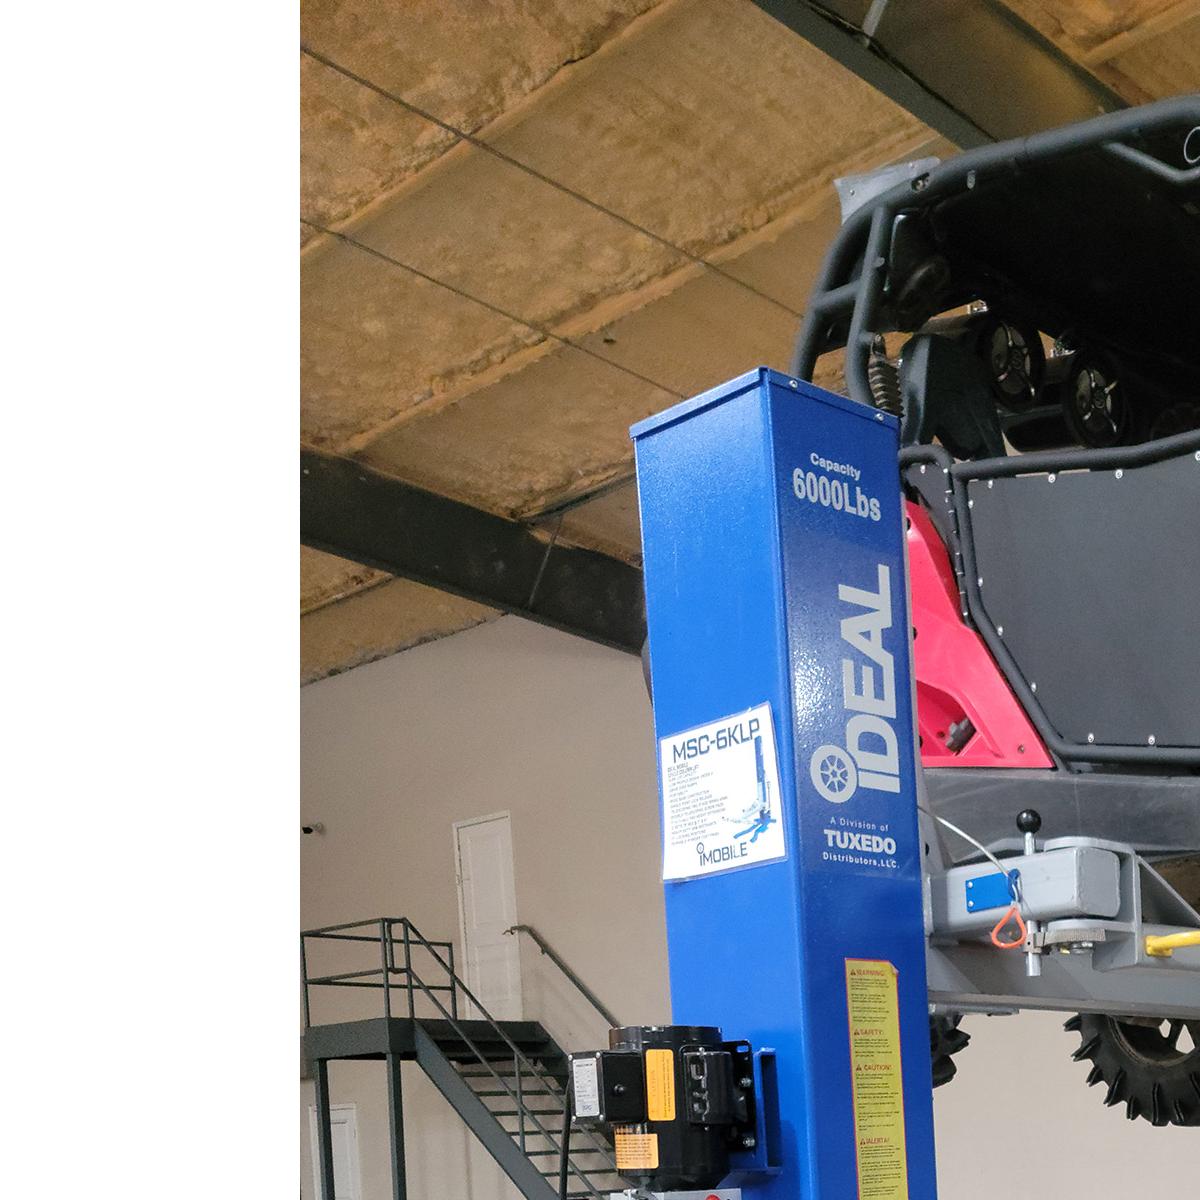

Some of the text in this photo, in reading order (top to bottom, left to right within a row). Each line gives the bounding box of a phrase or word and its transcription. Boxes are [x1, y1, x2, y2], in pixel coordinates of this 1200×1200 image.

[810, 452, 860, 481] Capacity
[793, 468, 881, 521] 6000Lbs
[672, 717, 760, 764] MSC-6KLP
[830, 816, 889, 832] A Division of
[823, 828, 897, 856] TUXEDO
